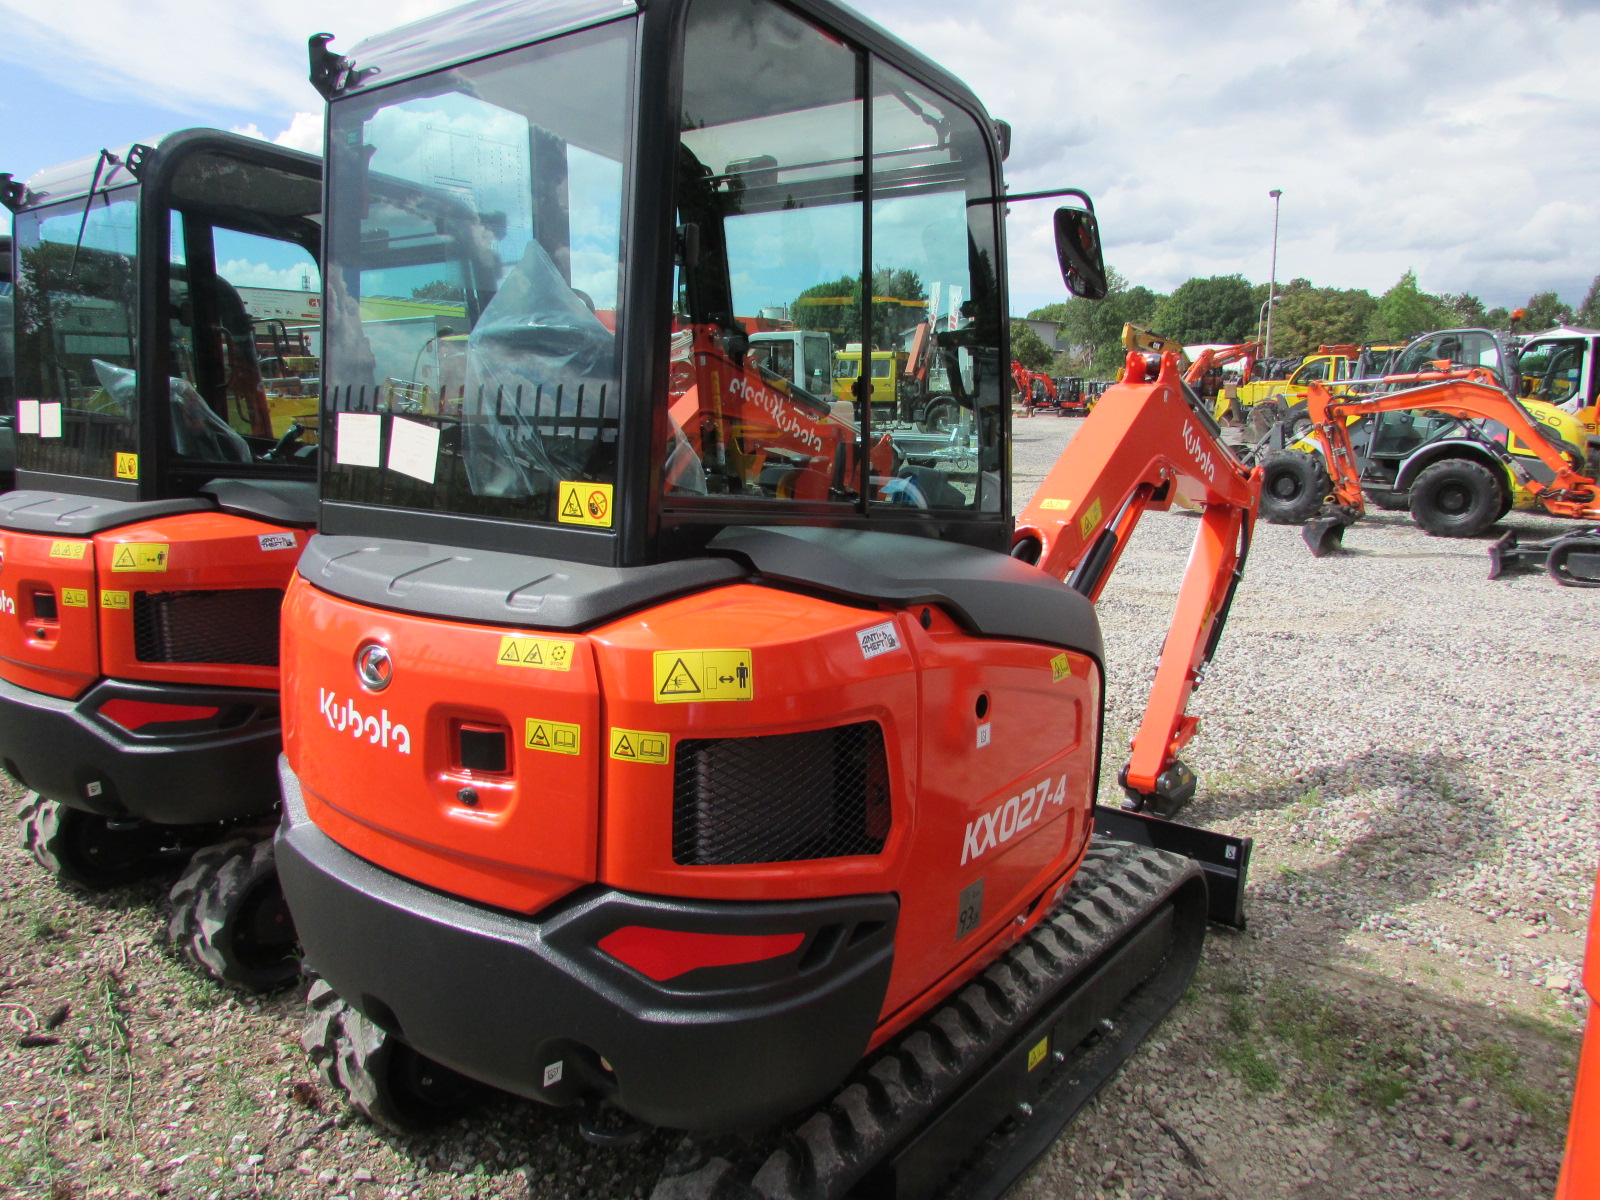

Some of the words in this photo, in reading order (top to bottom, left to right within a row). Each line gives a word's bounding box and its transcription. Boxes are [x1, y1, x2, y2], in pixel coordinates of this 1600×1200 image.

[1182, 419, 1215, 483] Kubota
[862, 632, 880, 645] ANTI
[862, 639, 885, 654] THEFT
[320, 687, 411, 755] Kubota
[960, 773, 1067, 867] KX027-4
